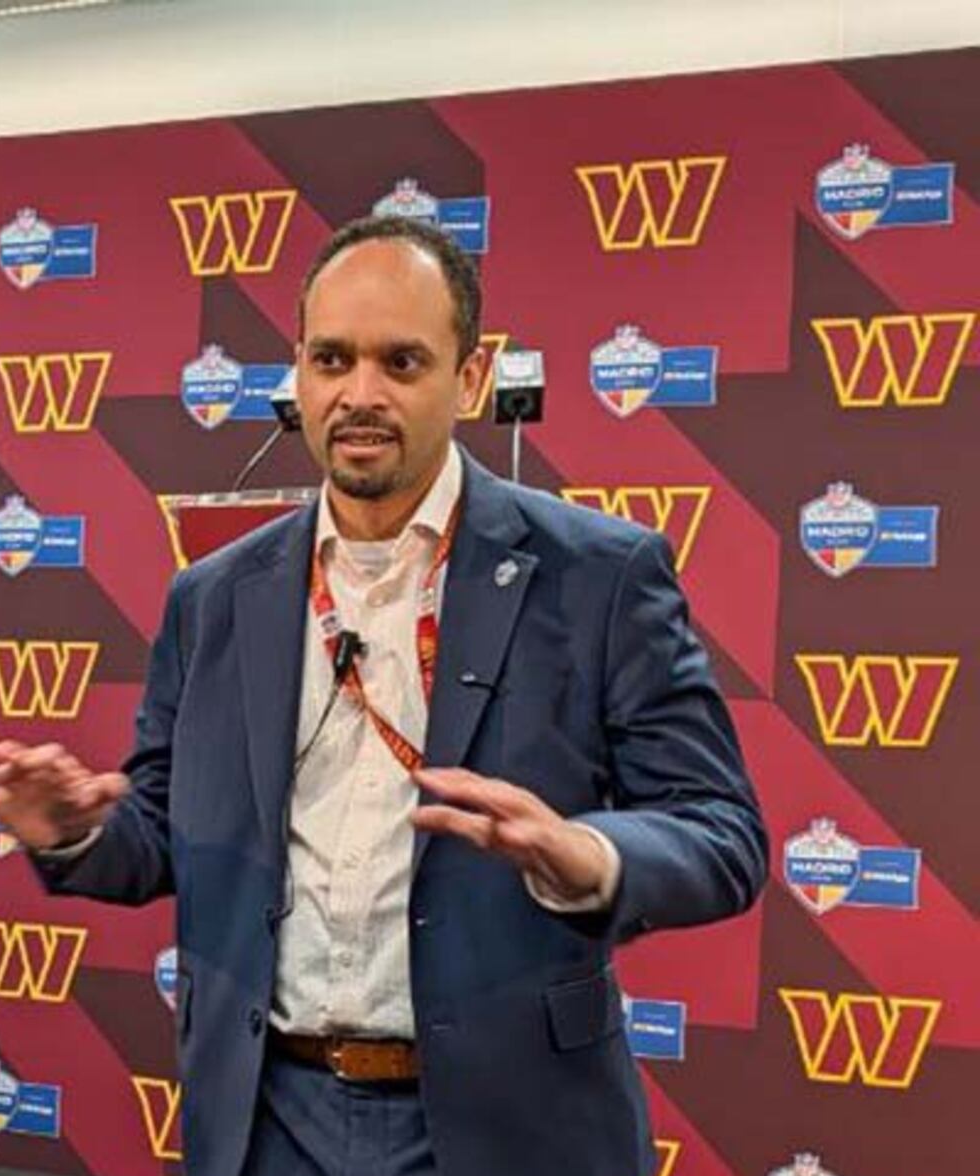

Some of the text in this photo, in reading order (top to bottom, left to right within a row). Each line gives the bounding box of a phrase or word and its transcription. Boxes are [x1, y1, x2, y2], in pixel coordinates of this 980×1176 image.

[169, 191, 297, 276] W
[576, 157, 726, 250] W
[811, 314, 977, 407] W
[795, 654, 959, 748] W
[791, 861, 853, 875] MADRID
[778, 988, 941, 1088] W
